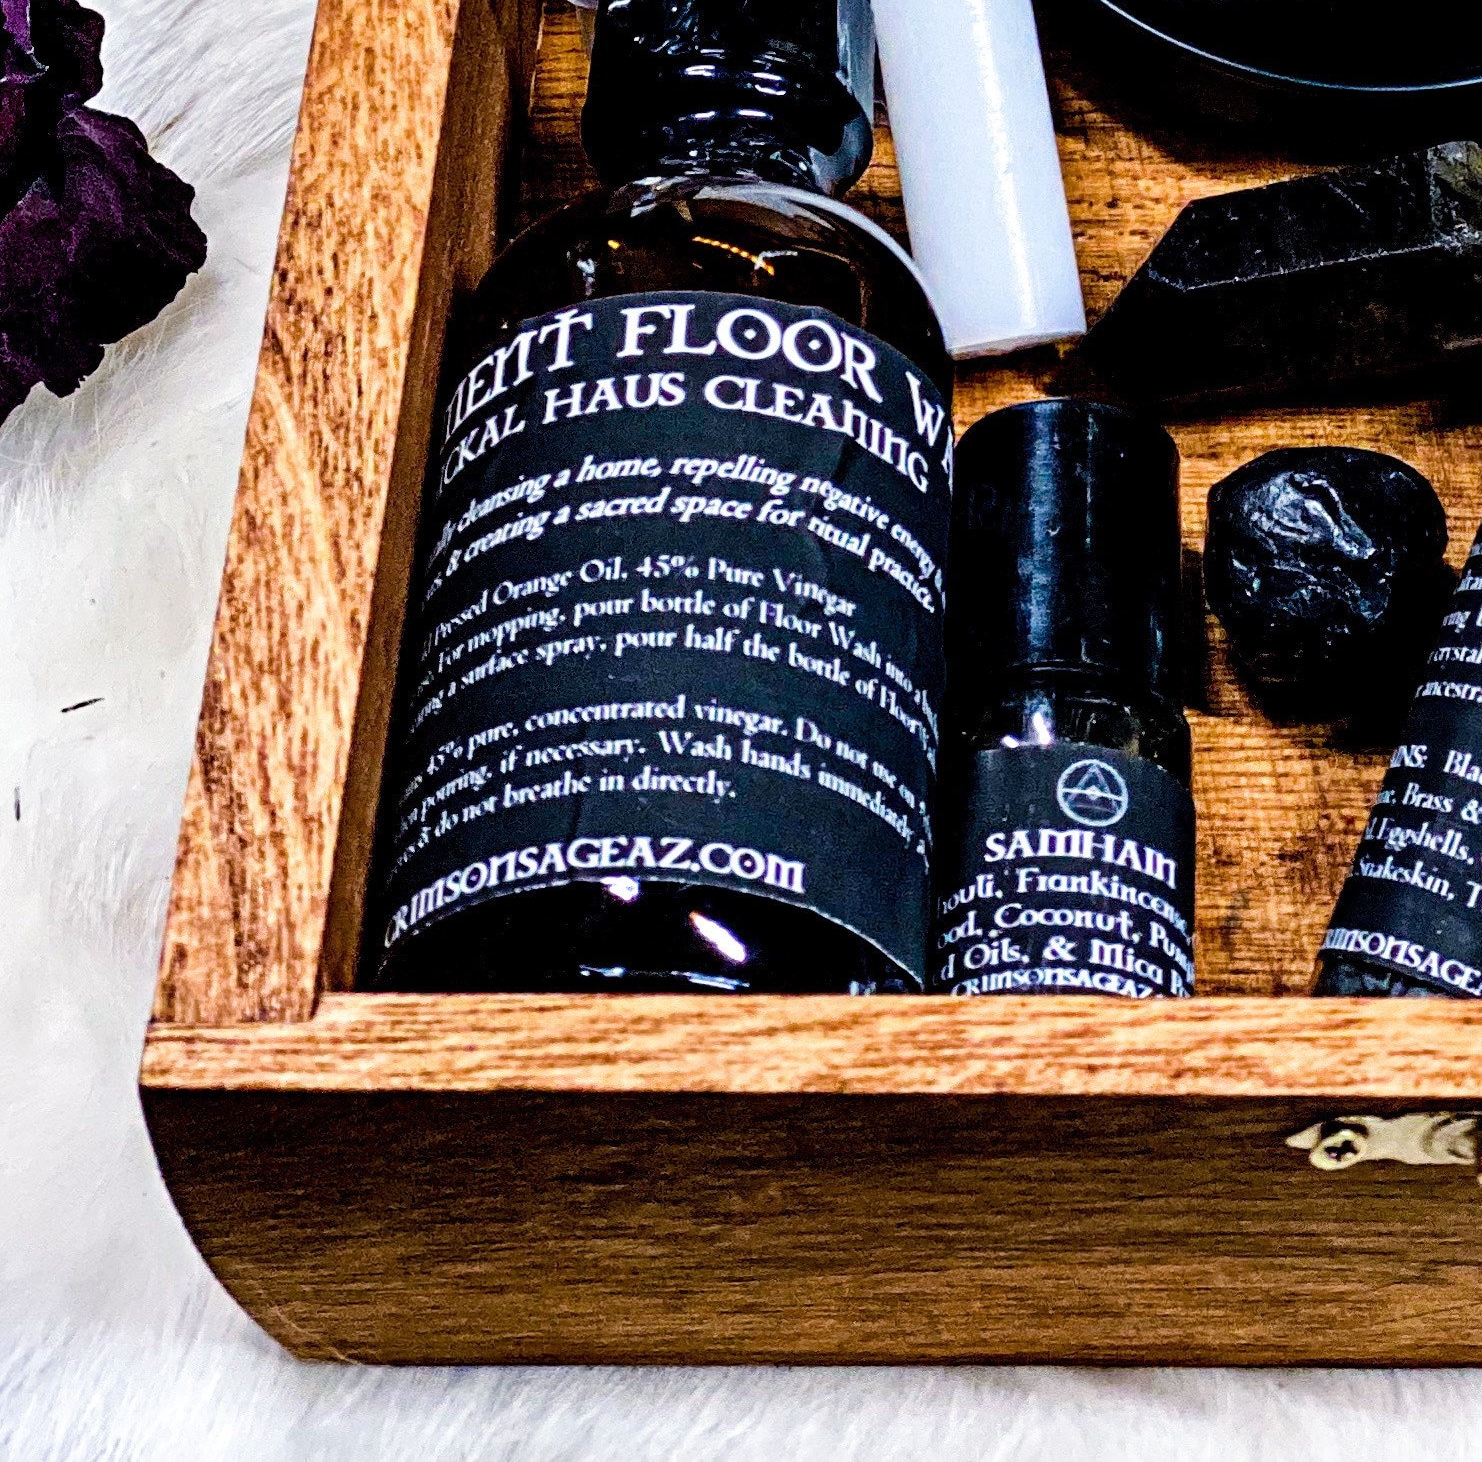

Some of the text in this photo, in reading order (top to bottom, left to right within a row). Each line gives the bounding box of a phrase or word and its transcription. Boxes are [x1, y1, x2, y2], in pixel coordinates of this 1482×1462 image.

[616, 298, 882, 408] FLOOR
[542, 372, 685, 424] HAUS
[704, 375, 928, 493] CLEANING
[669, 454, 797, 495] repelling
[575, 486, 753, 522] sacred space
[708, 557, 764, 587] Pure
[684, 624, 741, 652] half
[525, 694, 693, 740] concentrated
[657, 730, 811, 778] Wash hands
[503, 771, 591, 808] breathe
[984, 828, 1175, 889] SAMHAIN
[1042, 936, 1077, 961] &
[1088, 939, 1163, 984] Mica
